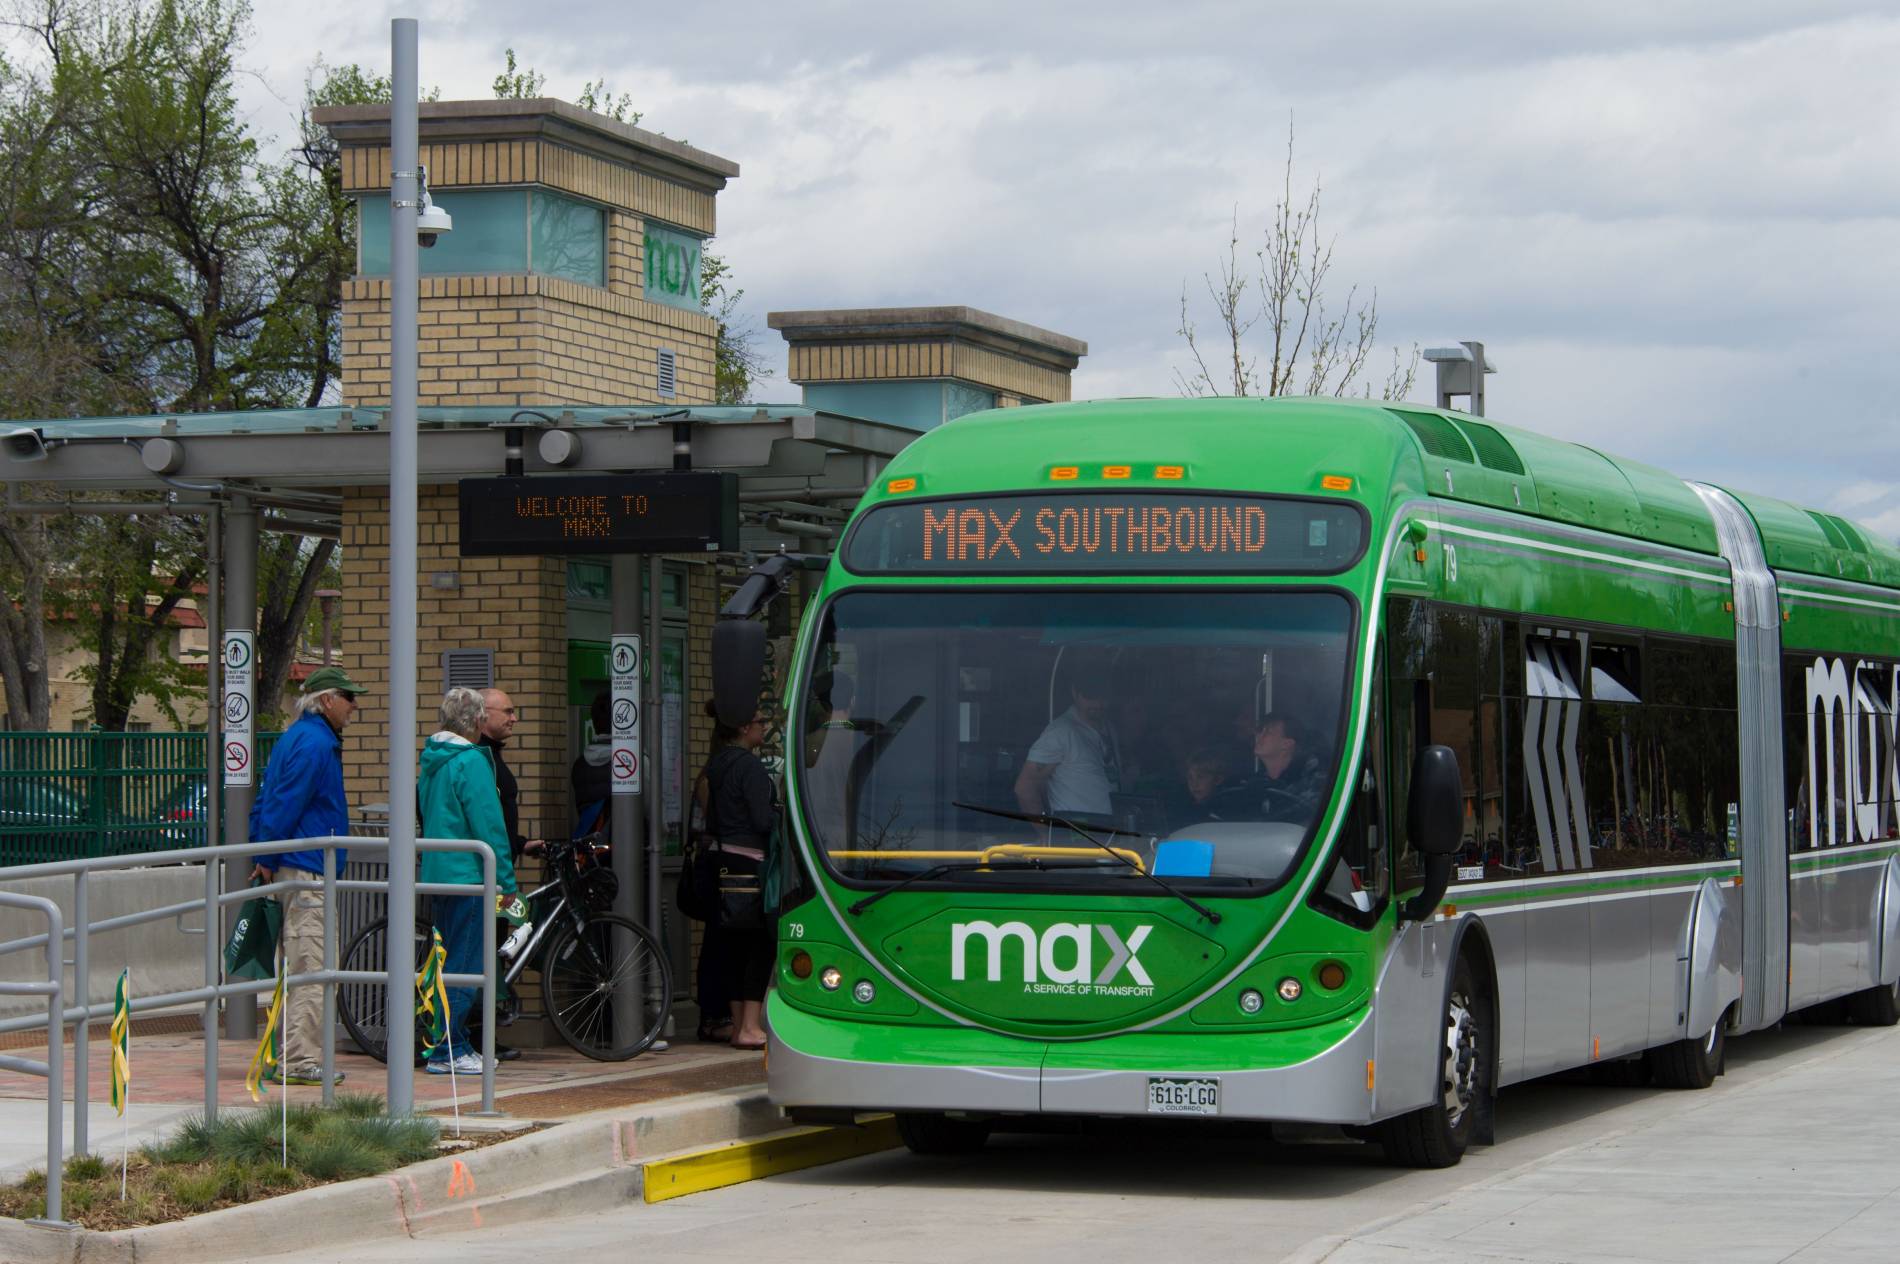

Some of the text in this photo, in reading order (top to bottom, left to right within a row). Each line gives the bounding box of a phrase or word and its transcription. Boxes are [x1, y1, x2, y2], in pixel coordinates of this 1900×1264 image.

[514, 495, 649, 516] WELCOME TO
[562, 517, 611, 537] MAX!
[922, 506, 1267, 560] MAX SOUTHBOUND
[1443, 543, 1458, 582] 79
[789, 923, 804, 938] 79
[951, 920, 1154, 986] max
[1024, 984, 1154, 997] A SERVICE OF TRANSFORT
